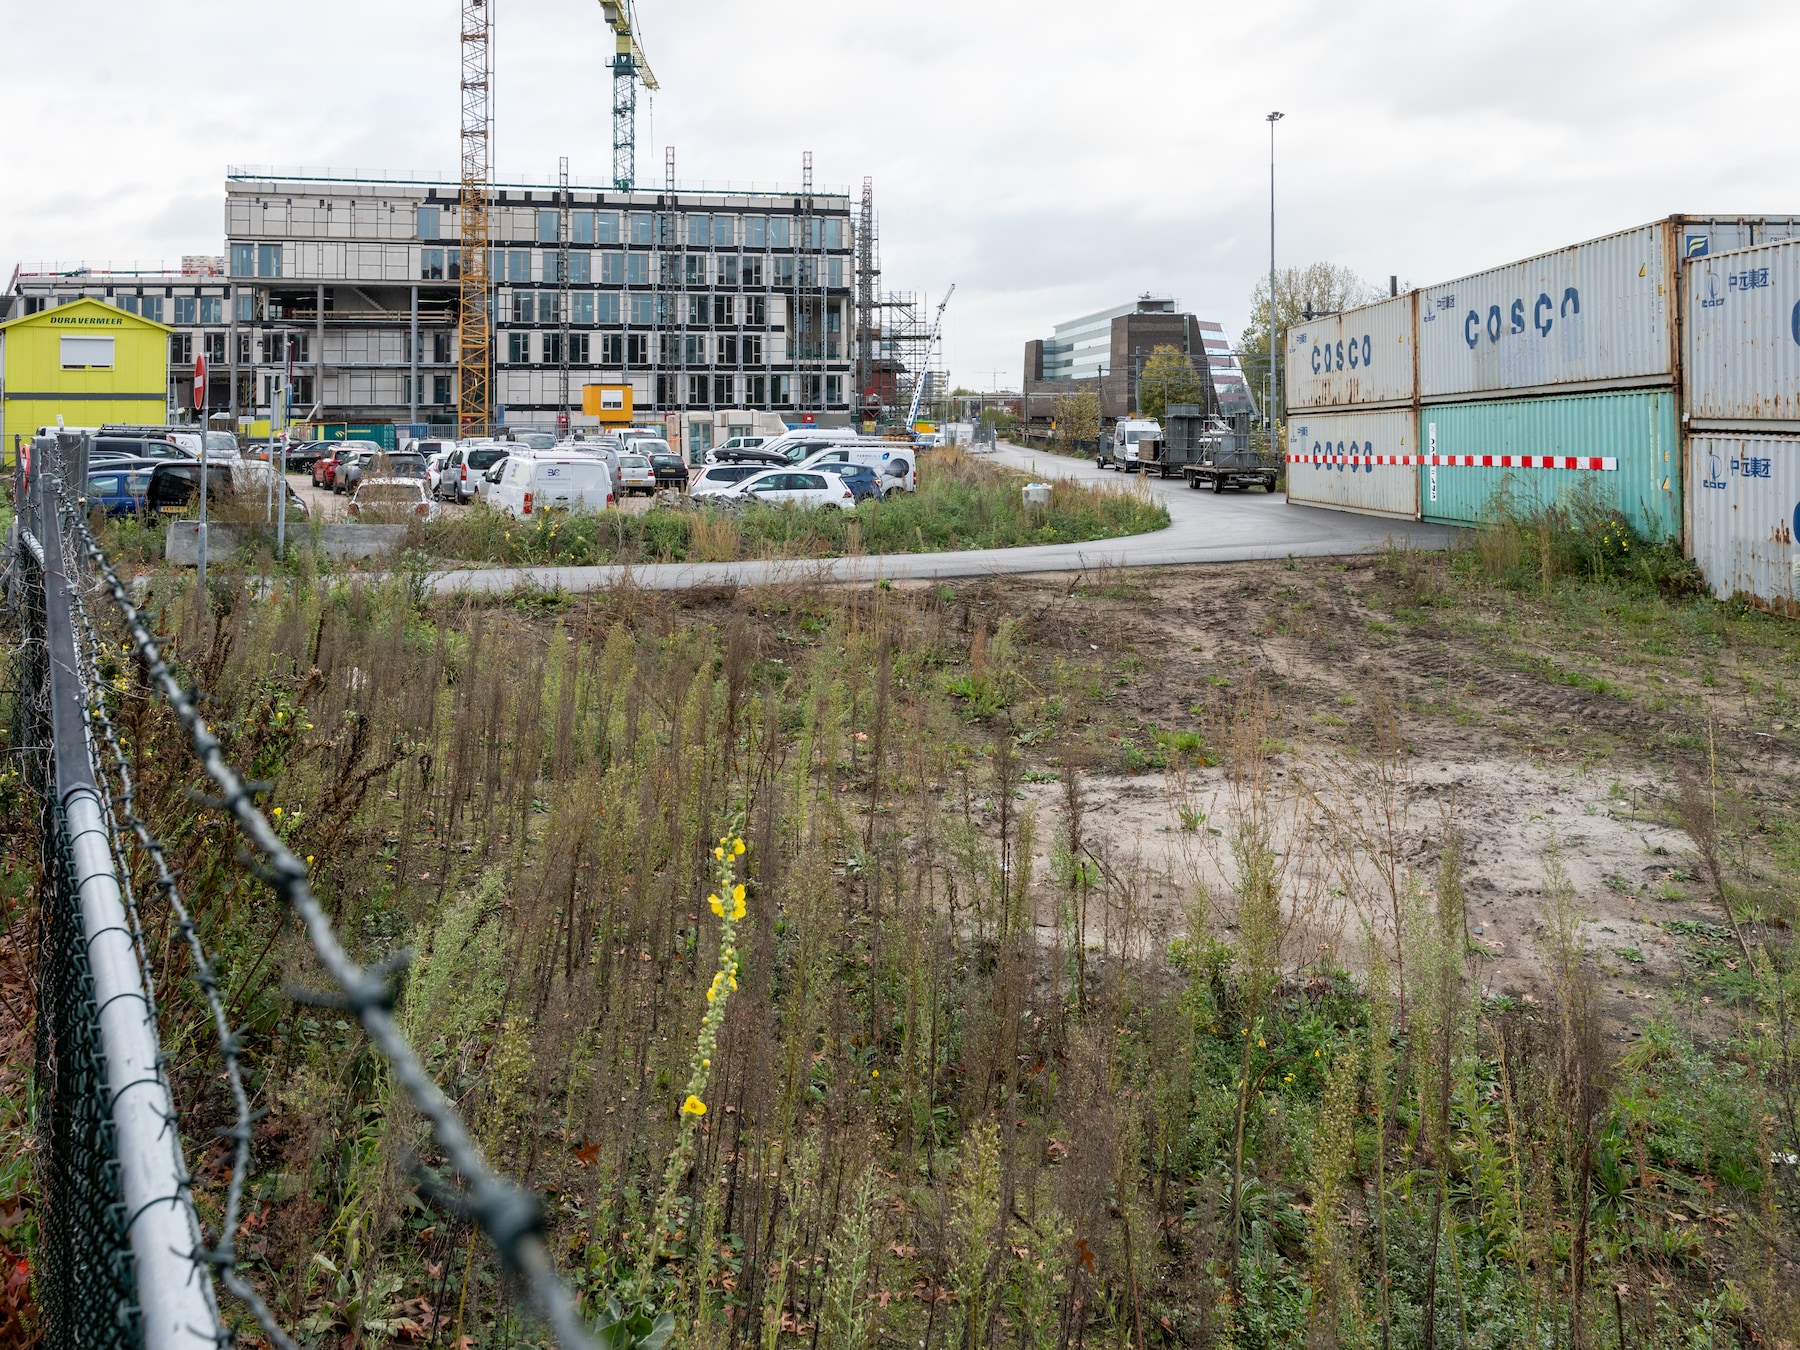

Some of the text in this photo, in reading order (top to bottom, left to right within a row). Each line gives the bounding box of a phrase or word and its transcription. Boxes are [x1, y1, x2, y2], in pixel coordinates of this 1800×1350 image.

[1464, 287, 1580, 349] COSCO
[1311, 334, 1371, 375] COSCO
[1313, 441, 1373, 473] COSCO
[1730, 456, 1771, 478] 中远集团
